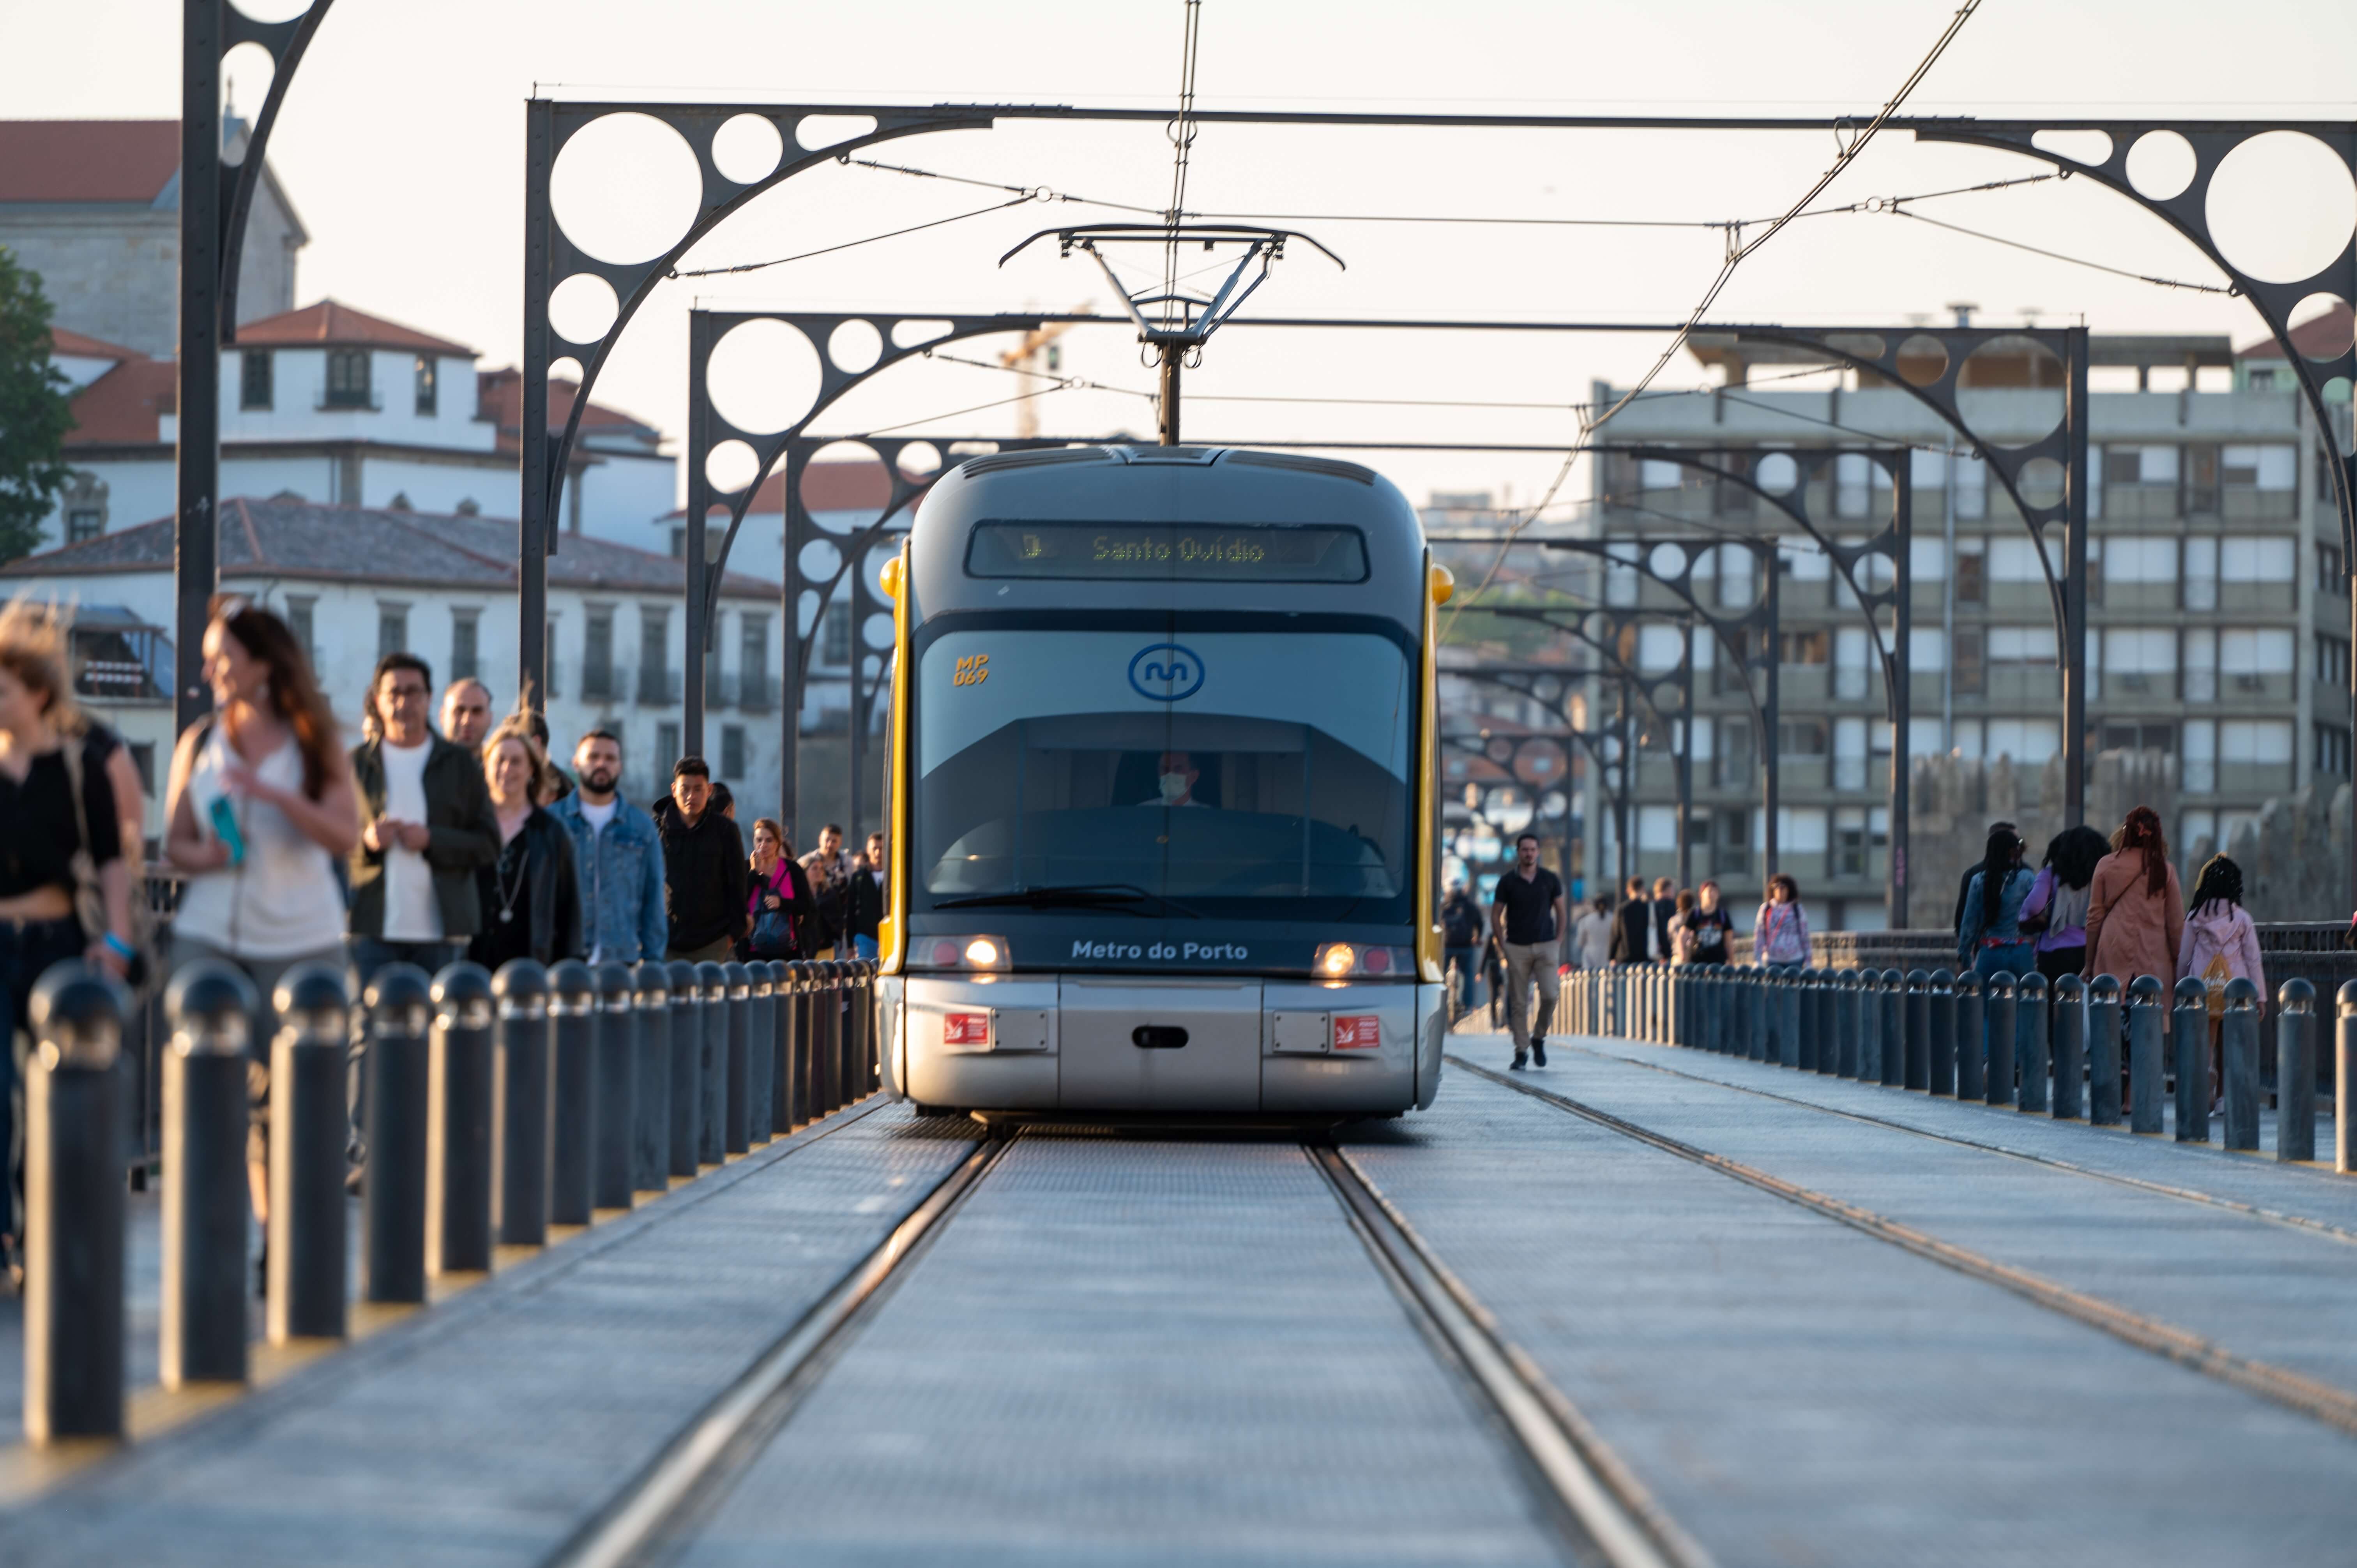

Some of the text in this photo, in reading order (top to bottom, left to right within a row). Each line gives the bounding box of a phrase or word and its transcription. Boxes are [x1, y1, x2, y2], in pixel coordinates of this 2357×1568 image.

[1093, 536, 1171, 561] Santo
[956, 655, 989, 672] MP
[953, 669, 989, 687] 069
[1072, 940, 1248, 960] Metro do Porto
